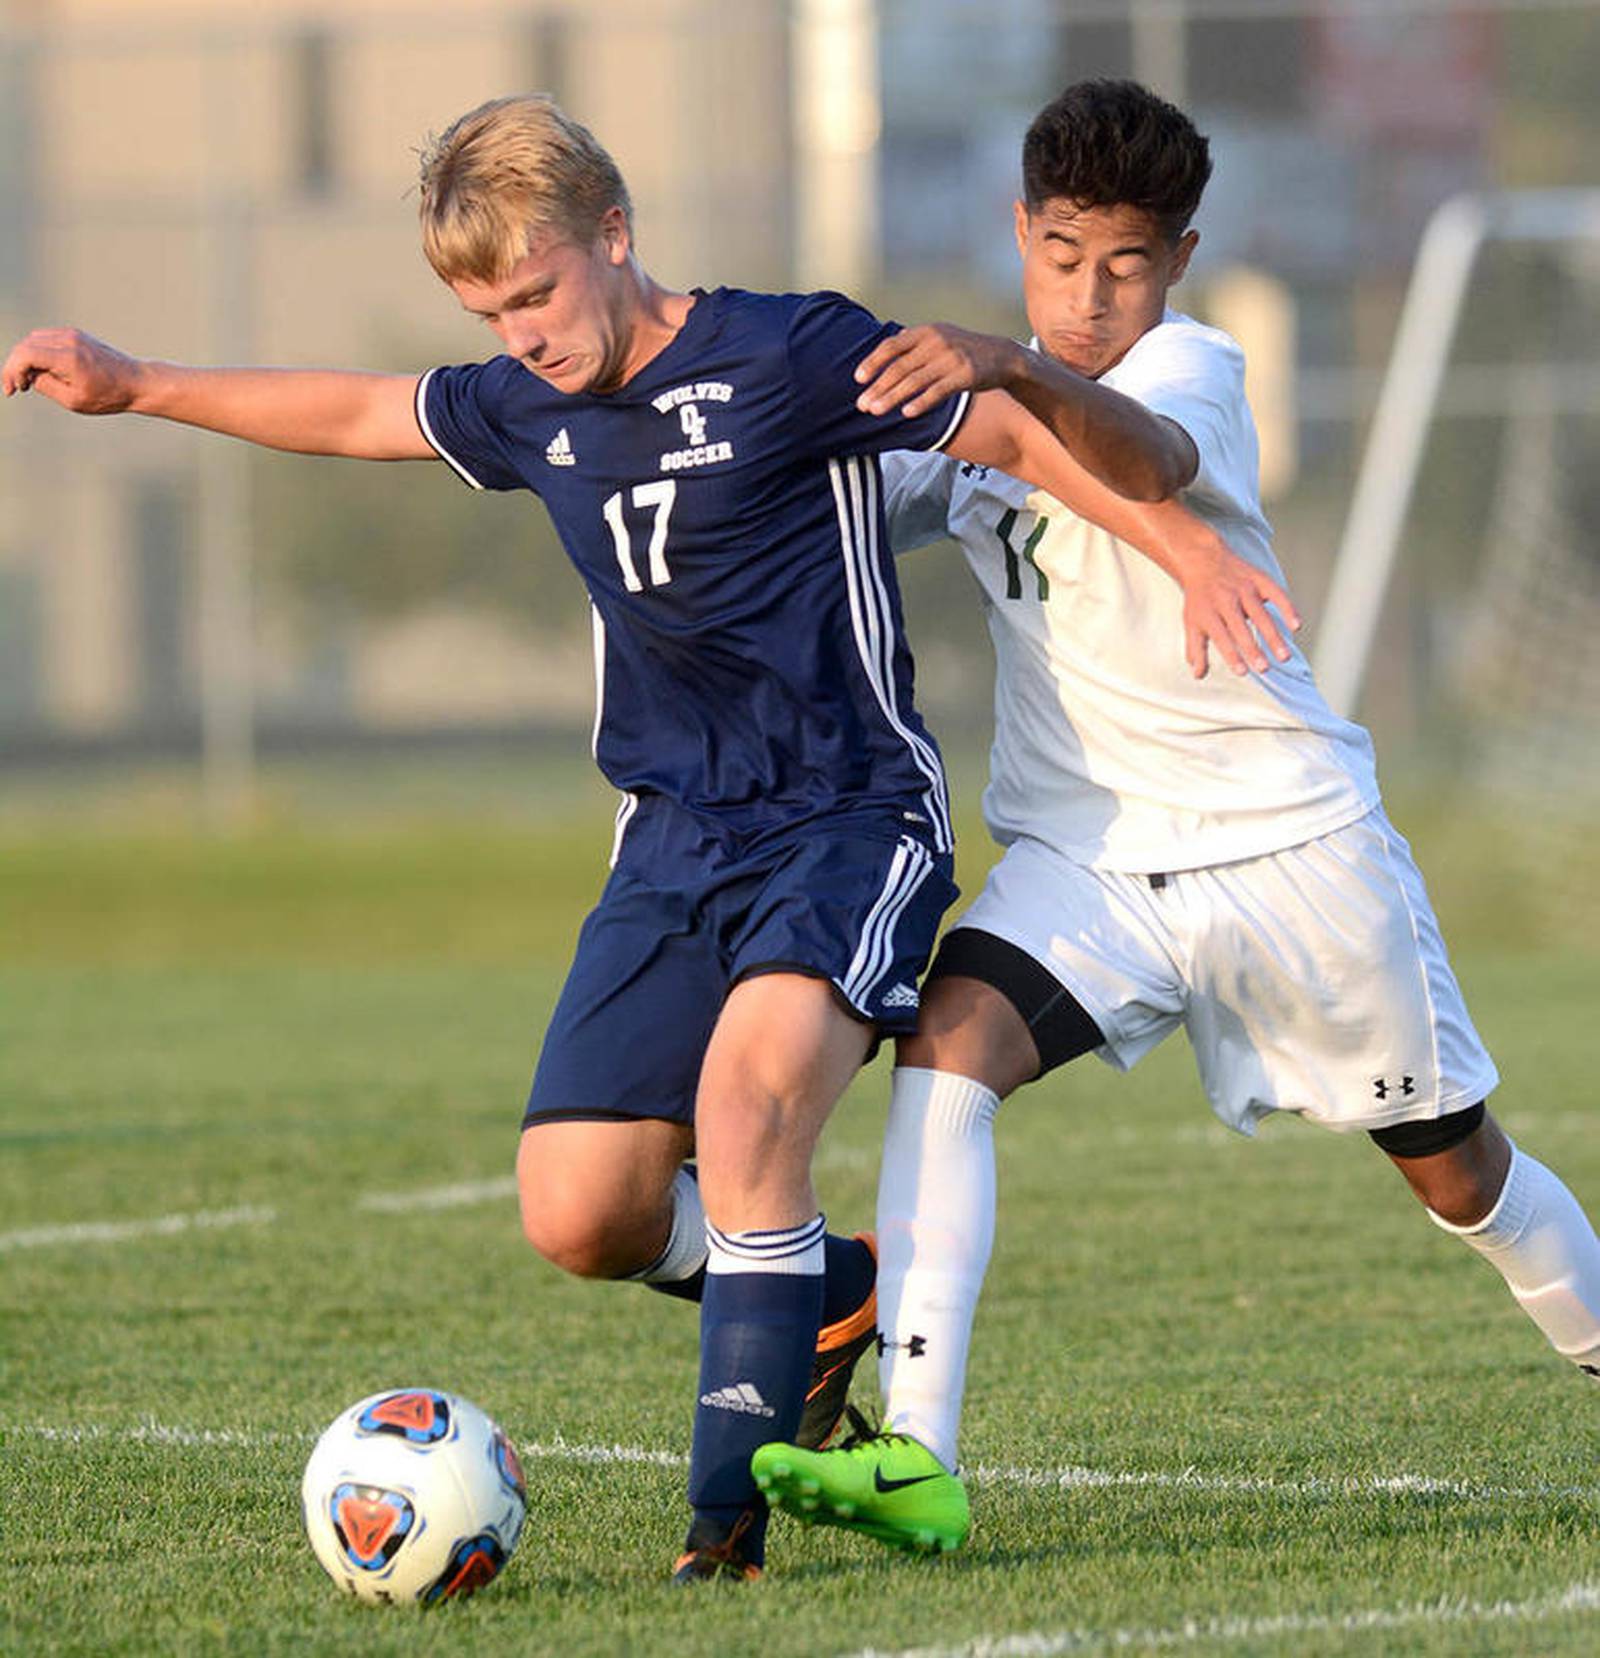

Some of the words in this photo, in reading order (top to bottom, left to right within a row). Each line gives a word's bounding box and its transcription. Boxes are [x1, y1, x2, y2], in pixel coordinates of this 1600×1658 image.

[652, 383, 733, 413] WOLVES
[660, 442, 733, 471] SOCCER
[603, 479, 676, 592] 17
[996, 508, 1049, 601] 11
[701, 1392, 775, 1417] adidas
